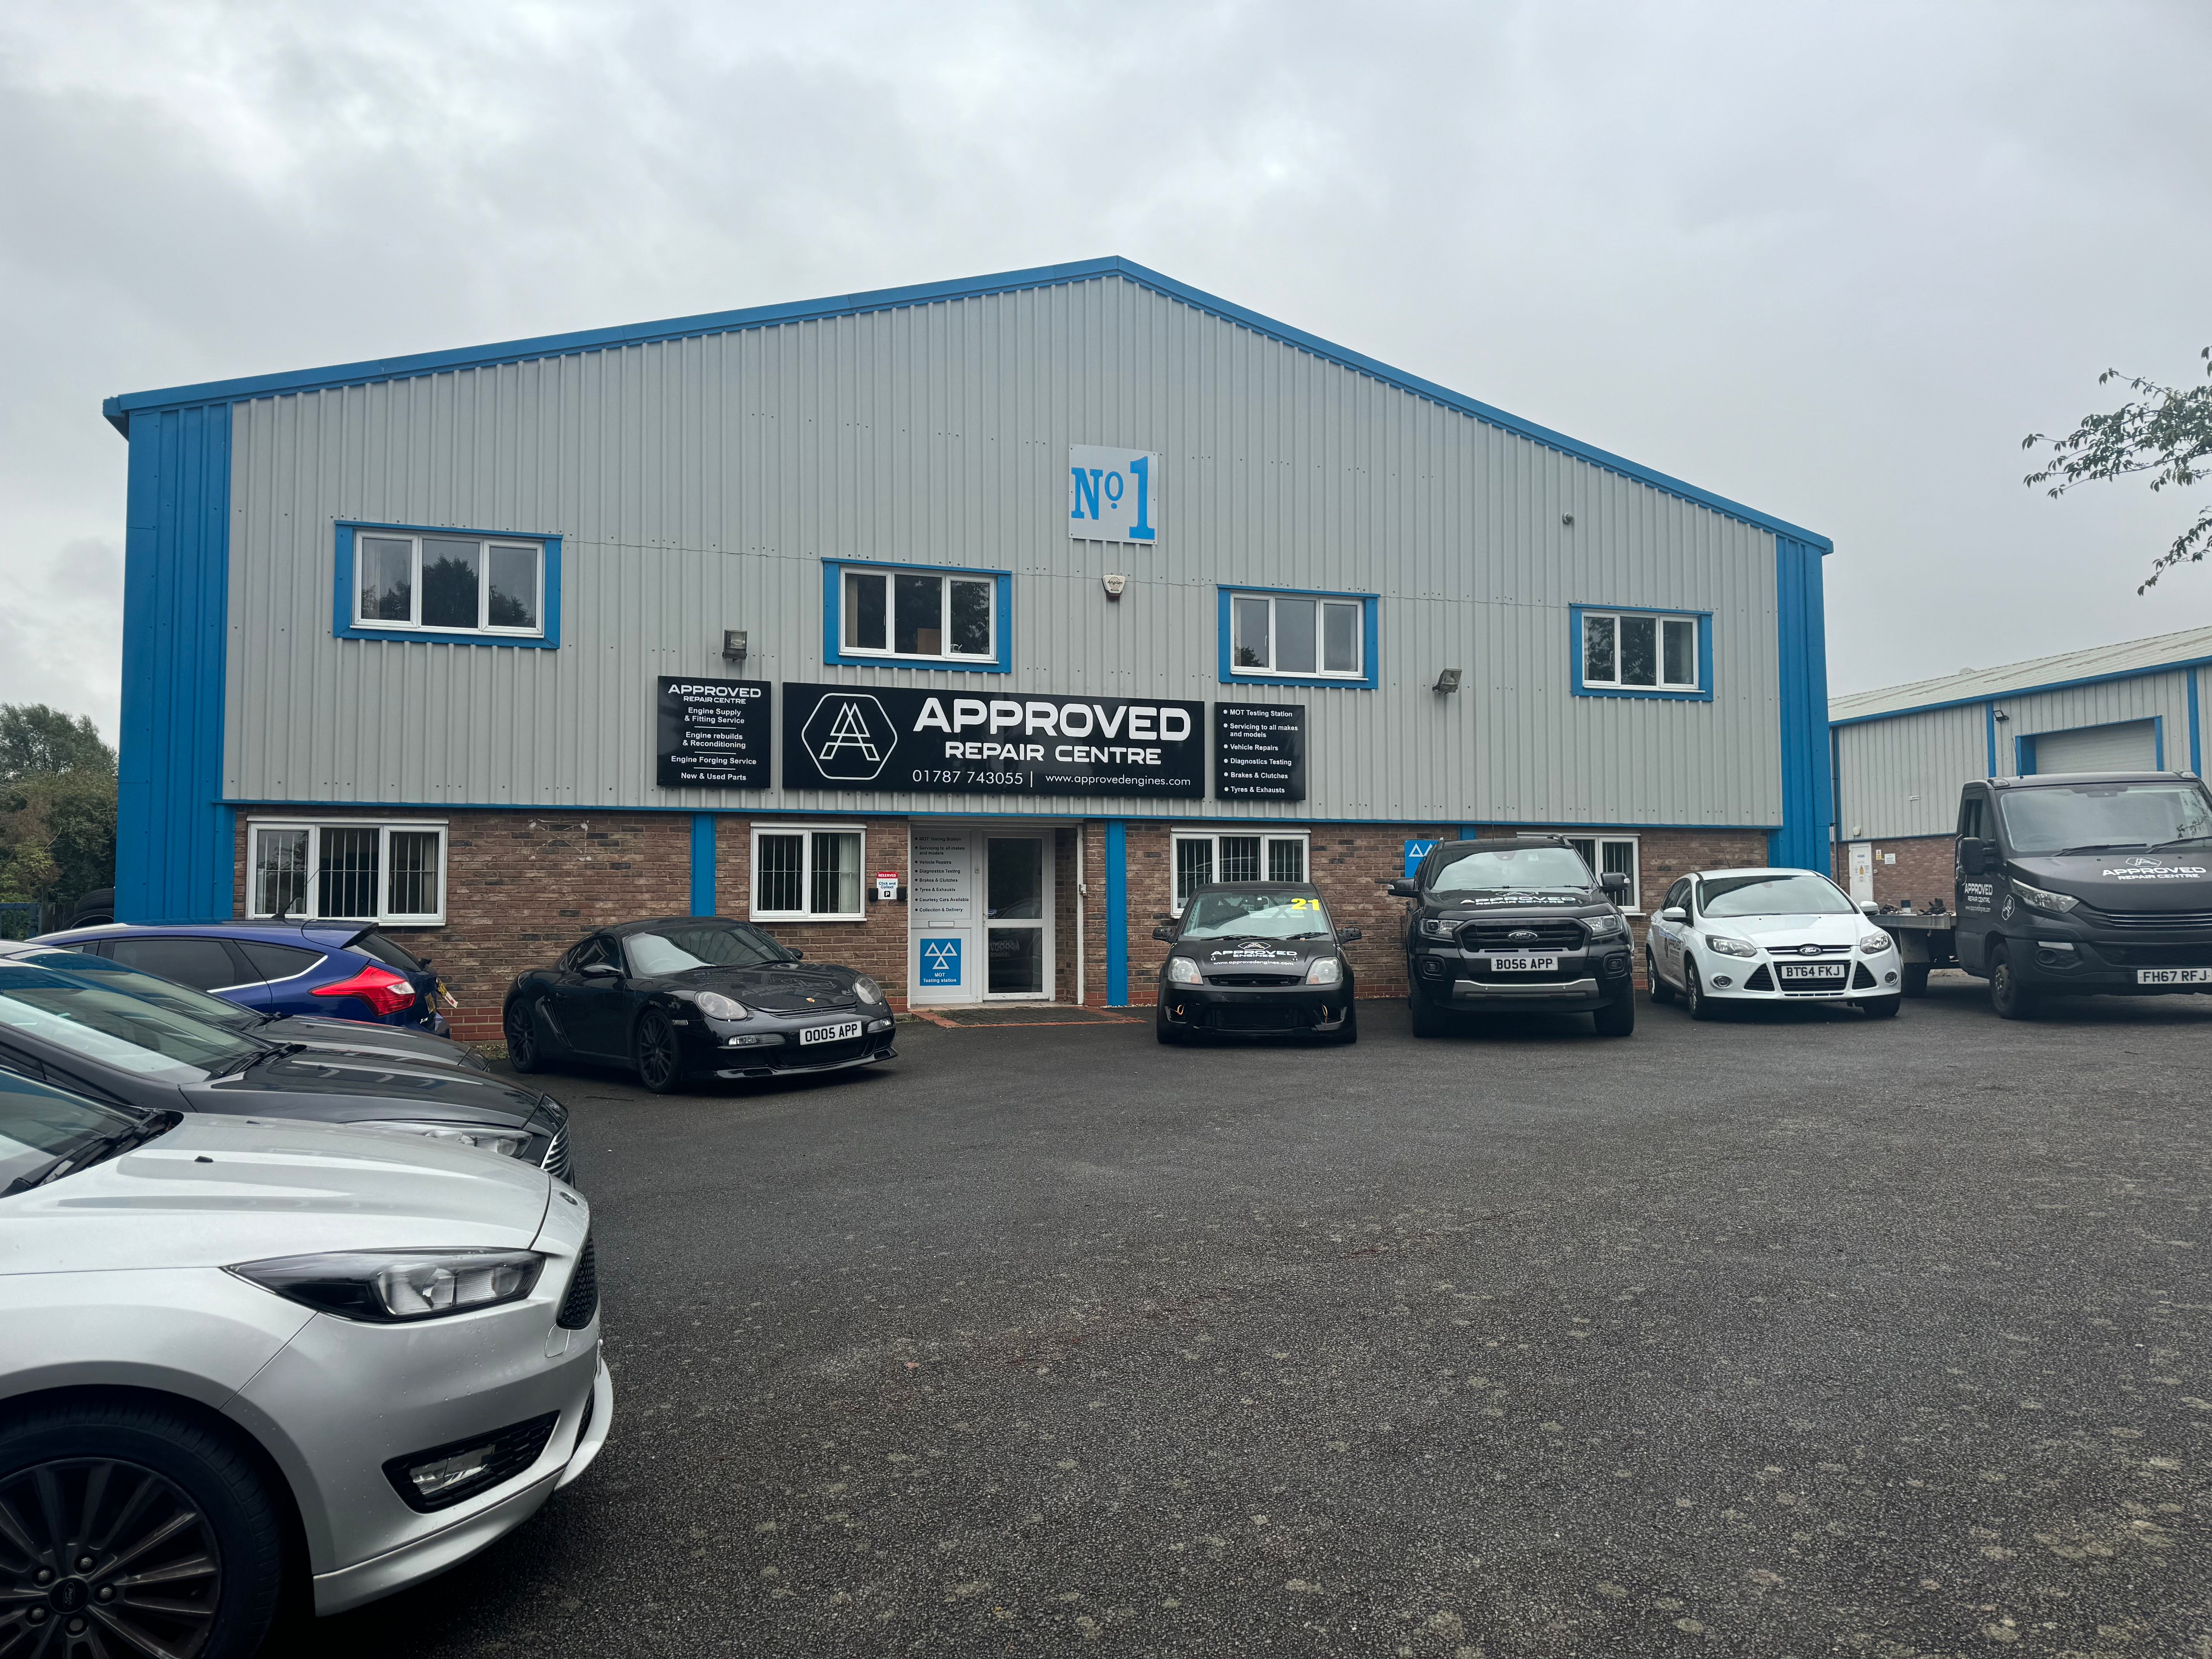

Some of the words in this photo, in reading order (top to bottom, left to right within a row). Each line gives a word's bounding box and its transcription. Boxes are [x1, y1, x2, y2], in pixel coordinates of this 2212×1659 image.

[668, 684, 761, 697] APPROVED
[716, 708, 741, 716] Supply
[913, 698, 1190, 741] APPROVED
[690, 740, 746, 749] Reconditioning
[945, 742, 1044, 761] REPAIR
[1055, 745, 1161, 764] CENTRE
[699, 757, 727, 765] Forging
[912, 769, 960, 783] 01787
[967, 771, 1023, 785] 743055
[1046, 775, 1190, 786] www.approvedengines.com
[2103, 867, 2207, 876] APPROVED
[1965, 883, 1993, 895] APPROVED
[1291, 898, 1320, 911] 21
[1496, 959, 1527, 969] BO56
[1531, 958, 1553, 969] APP
[1786, 967, 1815, 977] BT64
[1819, 966, 1839, 976] FKJ
[2143, 971, 2177, 982] FH67
[2181, 970, 2207, 981] RFJ
[839, 1024, 857, 1037] APP
